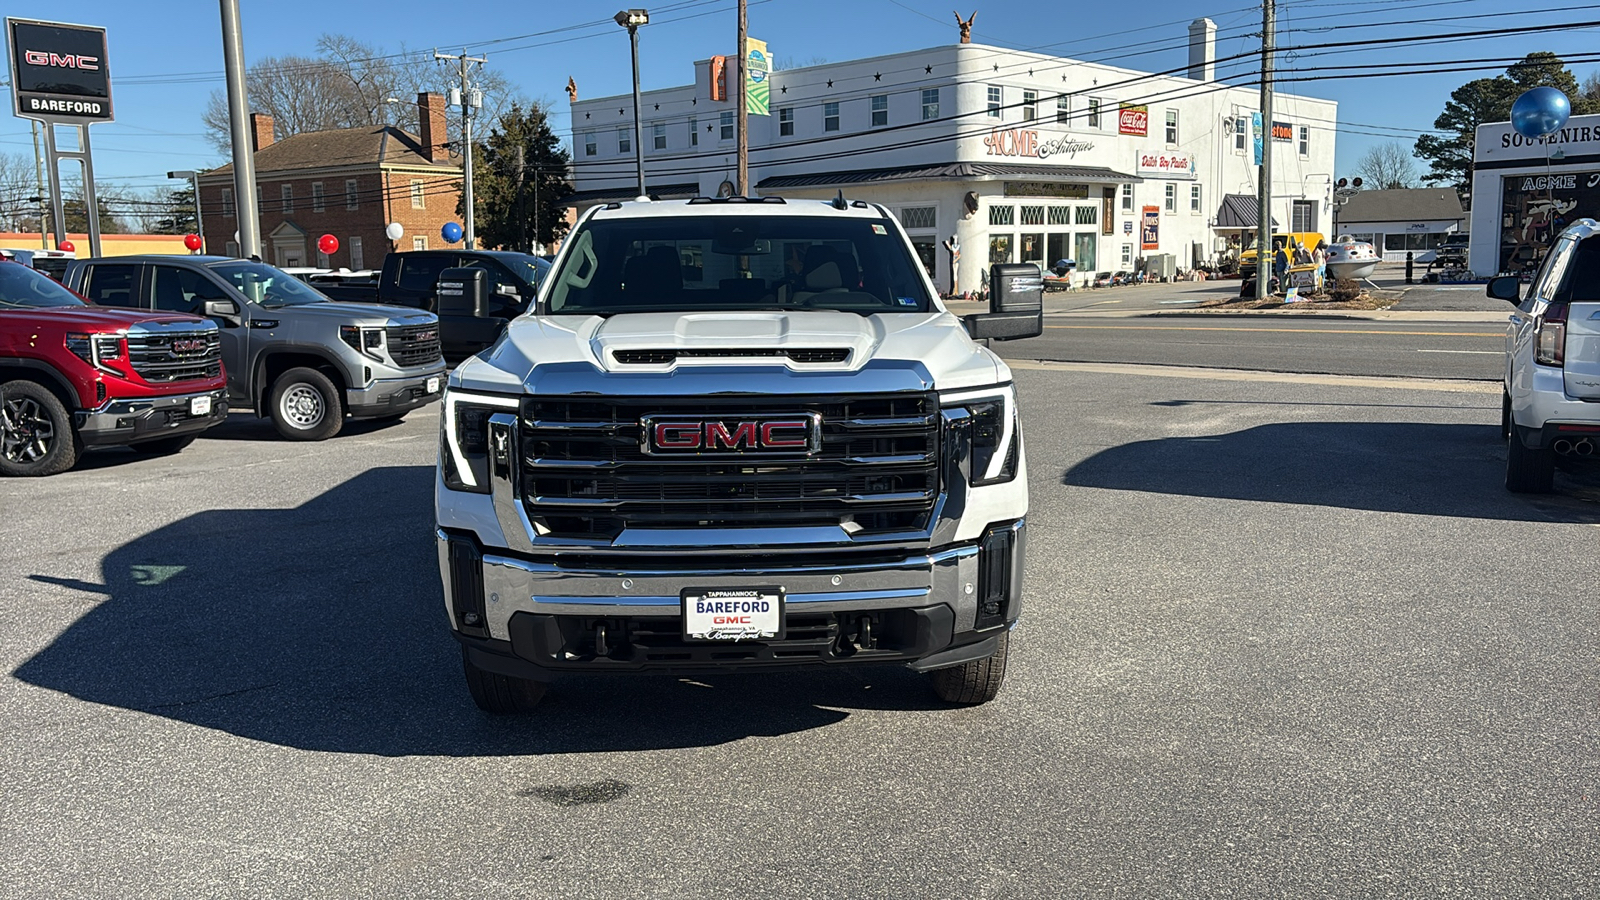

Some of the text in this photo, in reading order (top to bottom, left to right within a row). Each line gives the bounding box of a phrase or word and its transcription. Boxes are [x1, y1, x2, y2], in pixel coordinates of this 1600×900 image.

[25, 50, 99, 70] GMC
[30, 98, 101, 114] BAREFORD
[1271, 124, 1292, 139] stone
[983, 128, 1039, 158] ACME
[1141, 155, 1188, 171] Dutch Boy Paints
[1521, 175, 1577, 191] ACME
[1144, 230, 1157, 242] TEA
[655, 420, 807, 449] GMC
[696, 601, 770, 614] BAREFORD
[713, 616, 751, 625] GMC
[706, 630, 762, 643] Bareford
